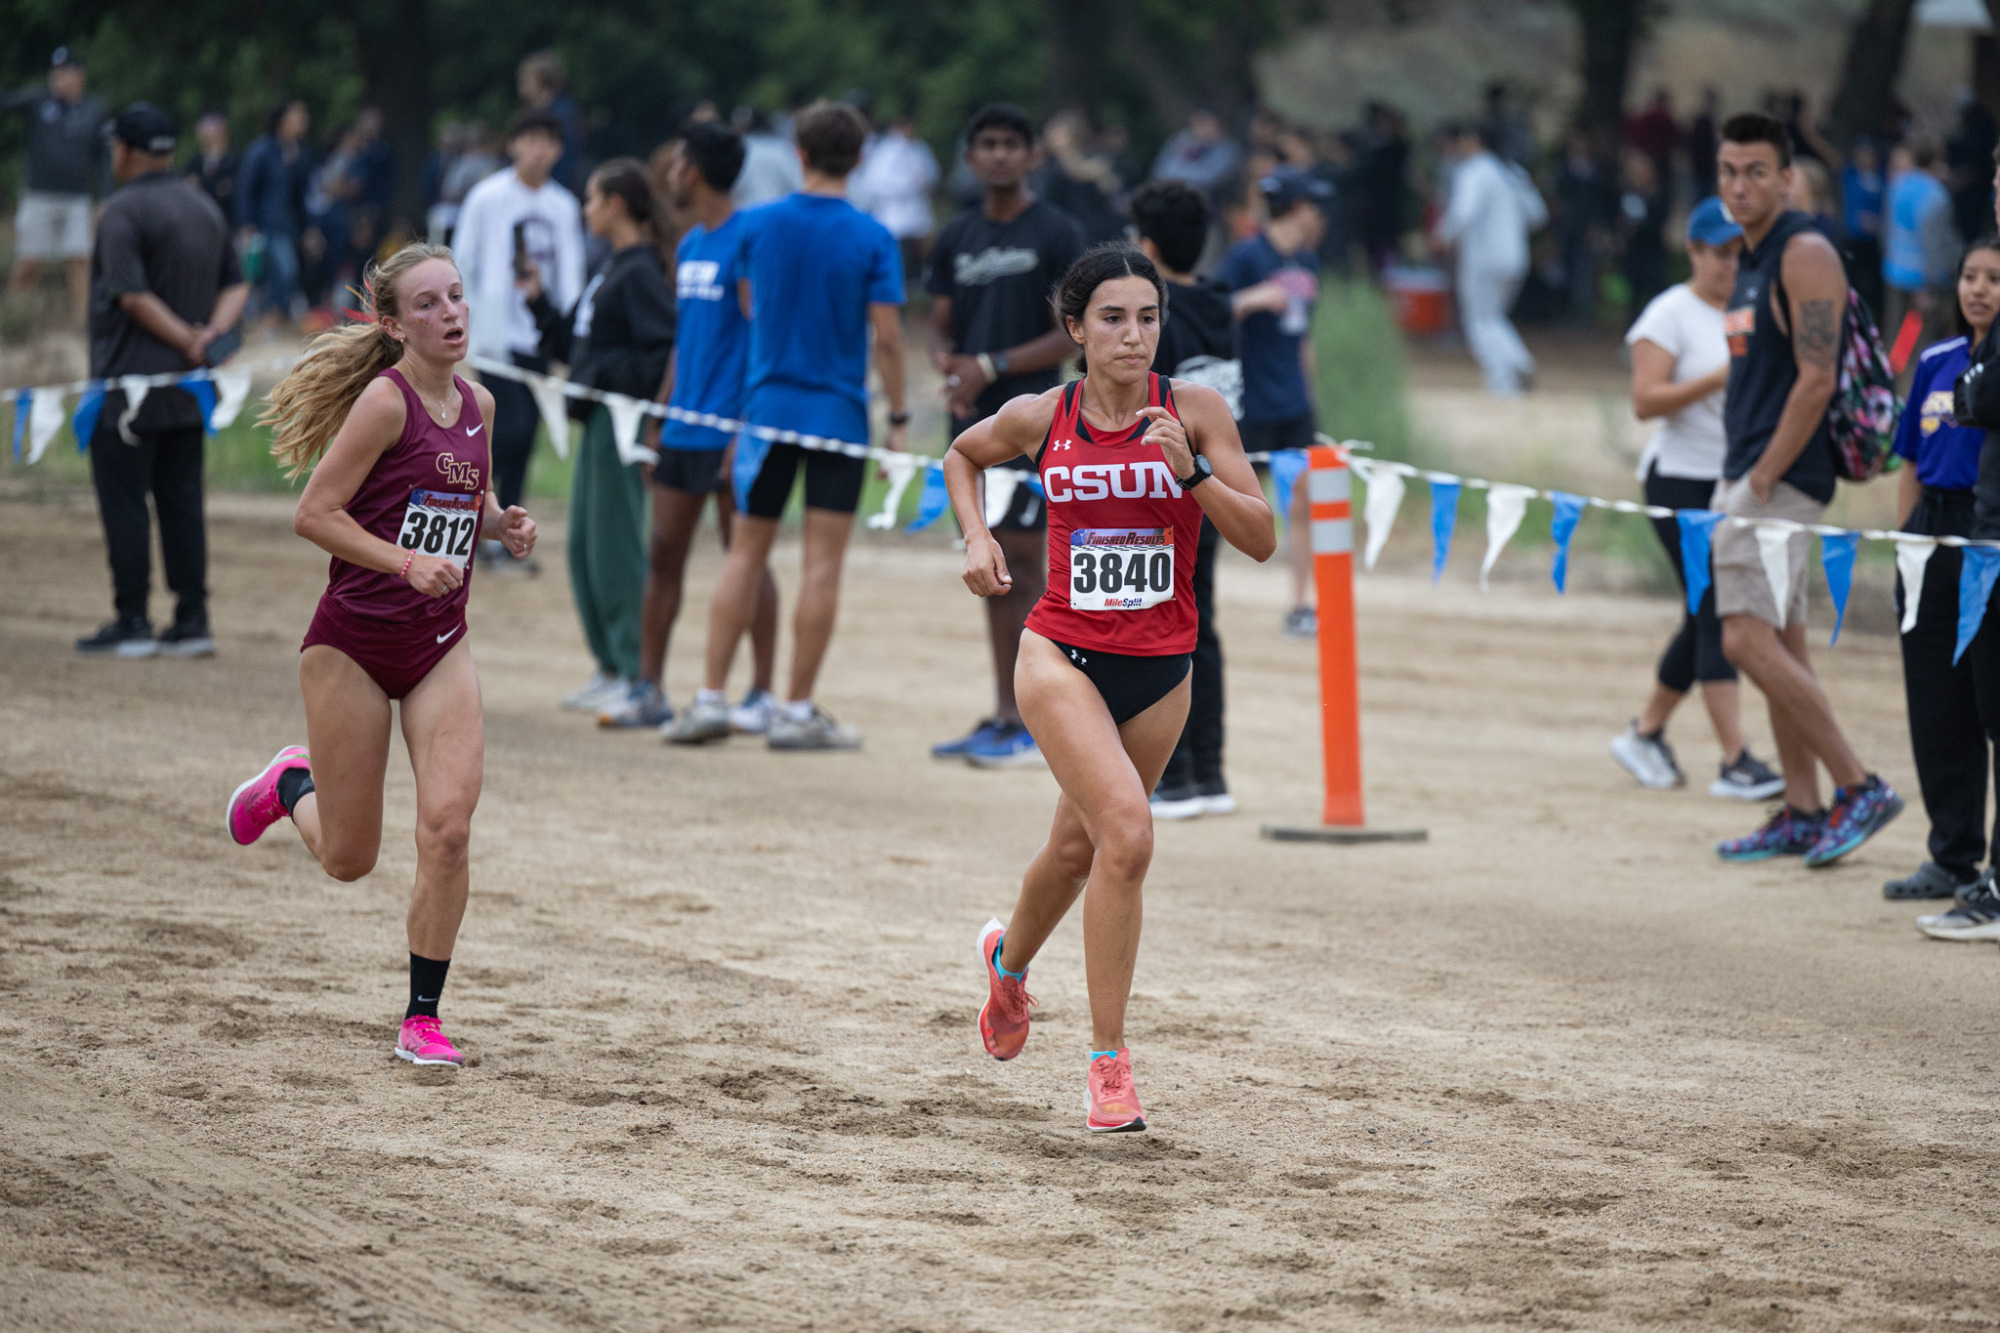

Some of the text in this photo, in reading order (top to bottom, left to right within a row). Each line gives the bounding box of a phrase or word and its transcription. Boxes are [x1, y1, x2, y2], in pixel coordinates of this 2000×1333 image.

[436, 452, 480, 490] CMS
[1044, 461, 1183, 503] CSUN
[401, 511, 475, 556] 3812
[1073, 552, 1171, 593] 3840
